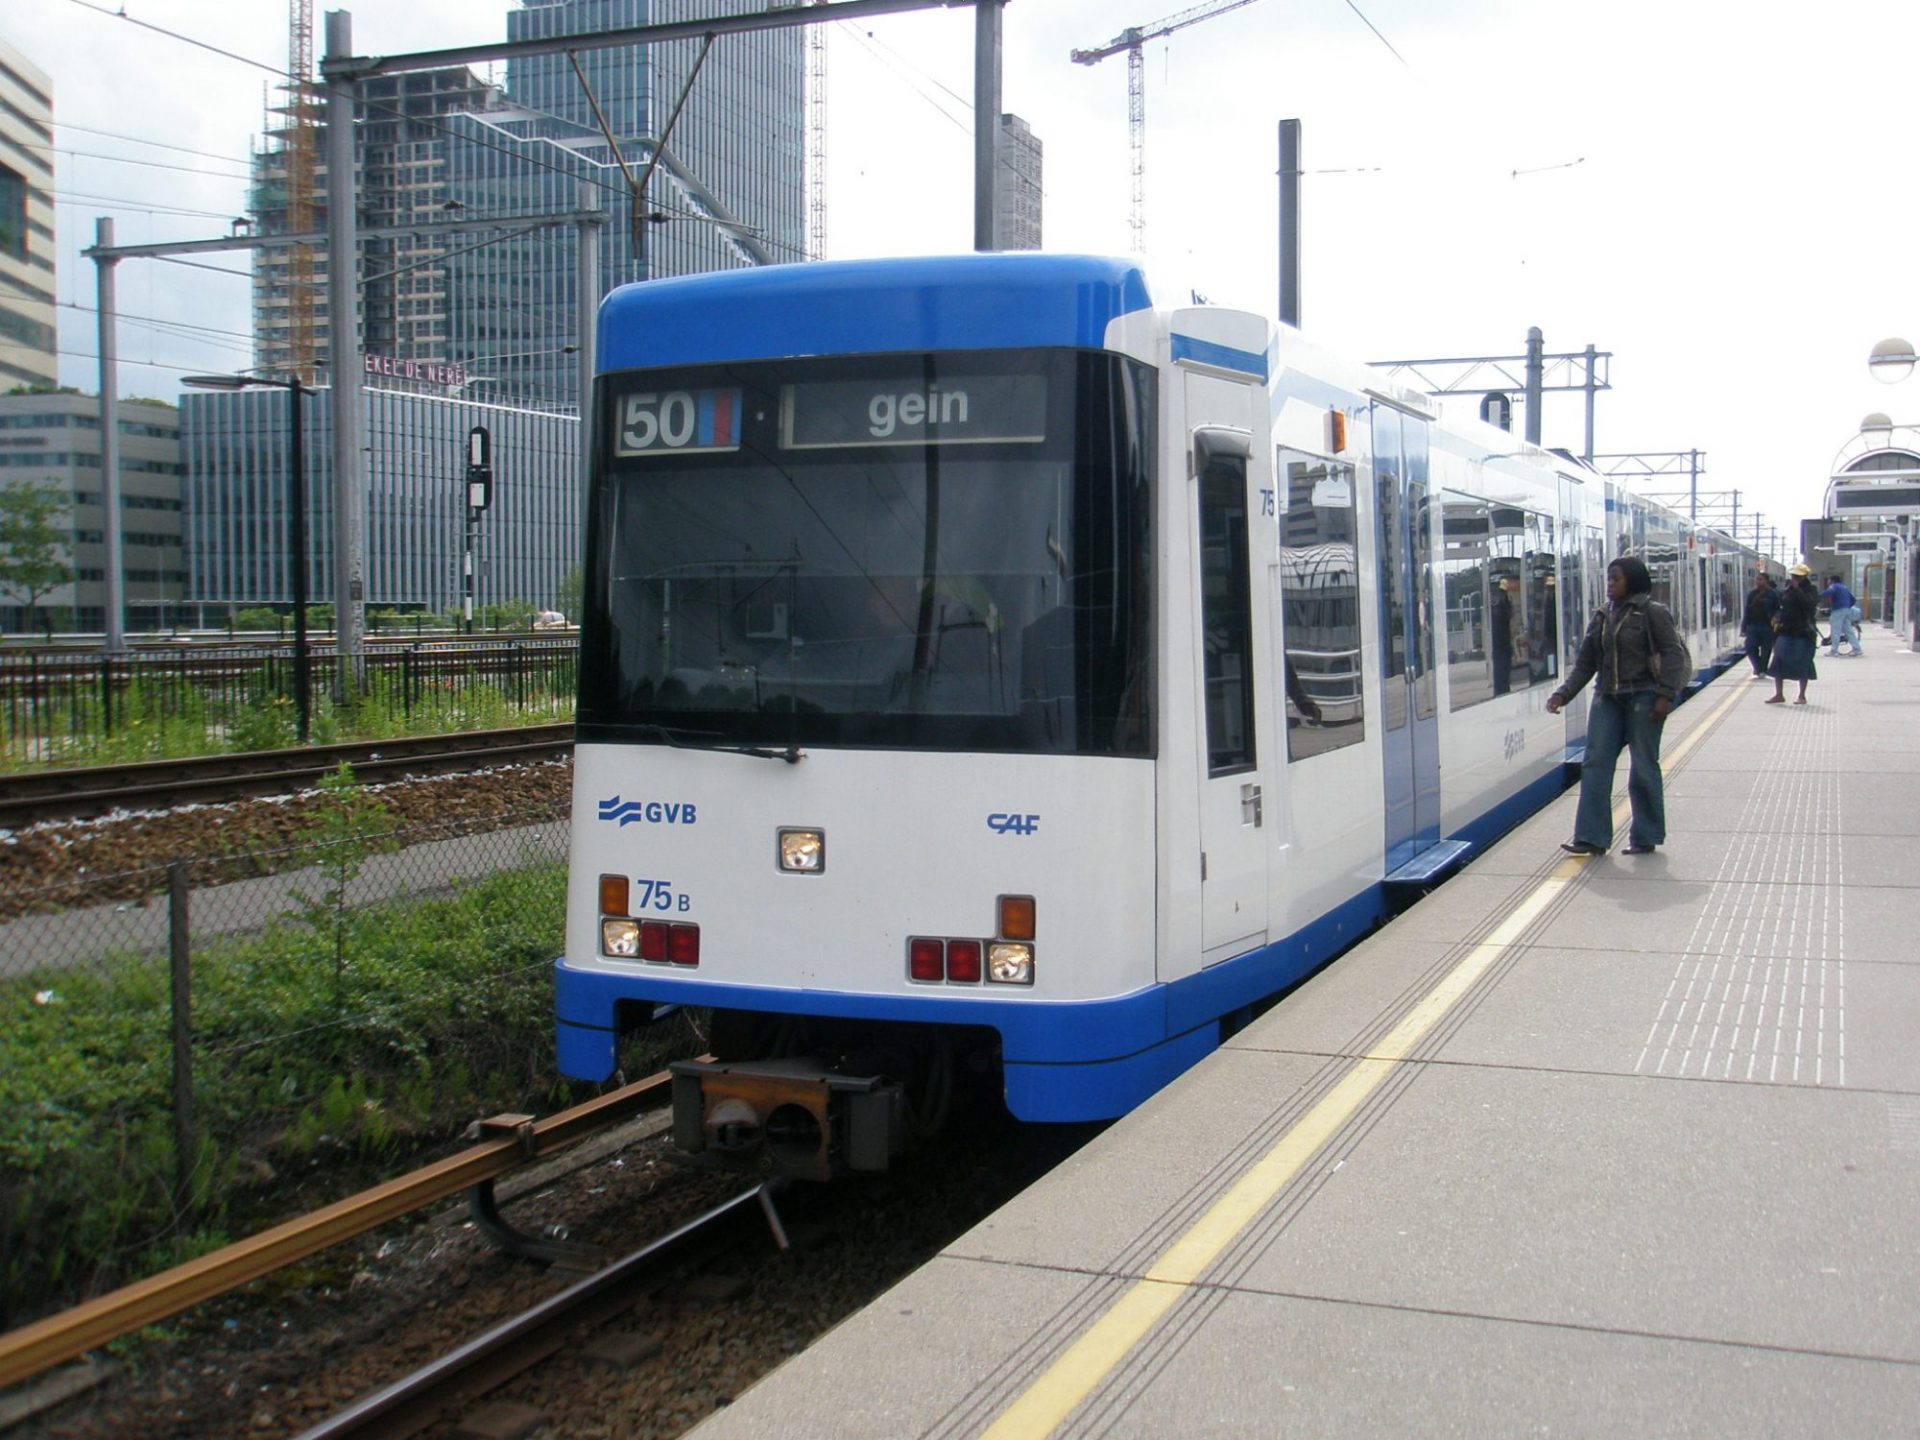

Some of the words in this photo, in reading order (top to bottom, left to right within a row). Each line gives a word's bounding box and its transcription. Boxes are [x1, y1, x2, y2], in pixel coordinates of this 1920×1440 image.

[406, 360, 422, 380] DE
[623, 391, 695, 449] 50
[868, 383, 968, 437] gein
[1259, 489, 1275, 517] 75
[645, 802, 697, 824] GVB
[986, 813, 1040, 835] CAF
[637, 879, 672, 910] 75
